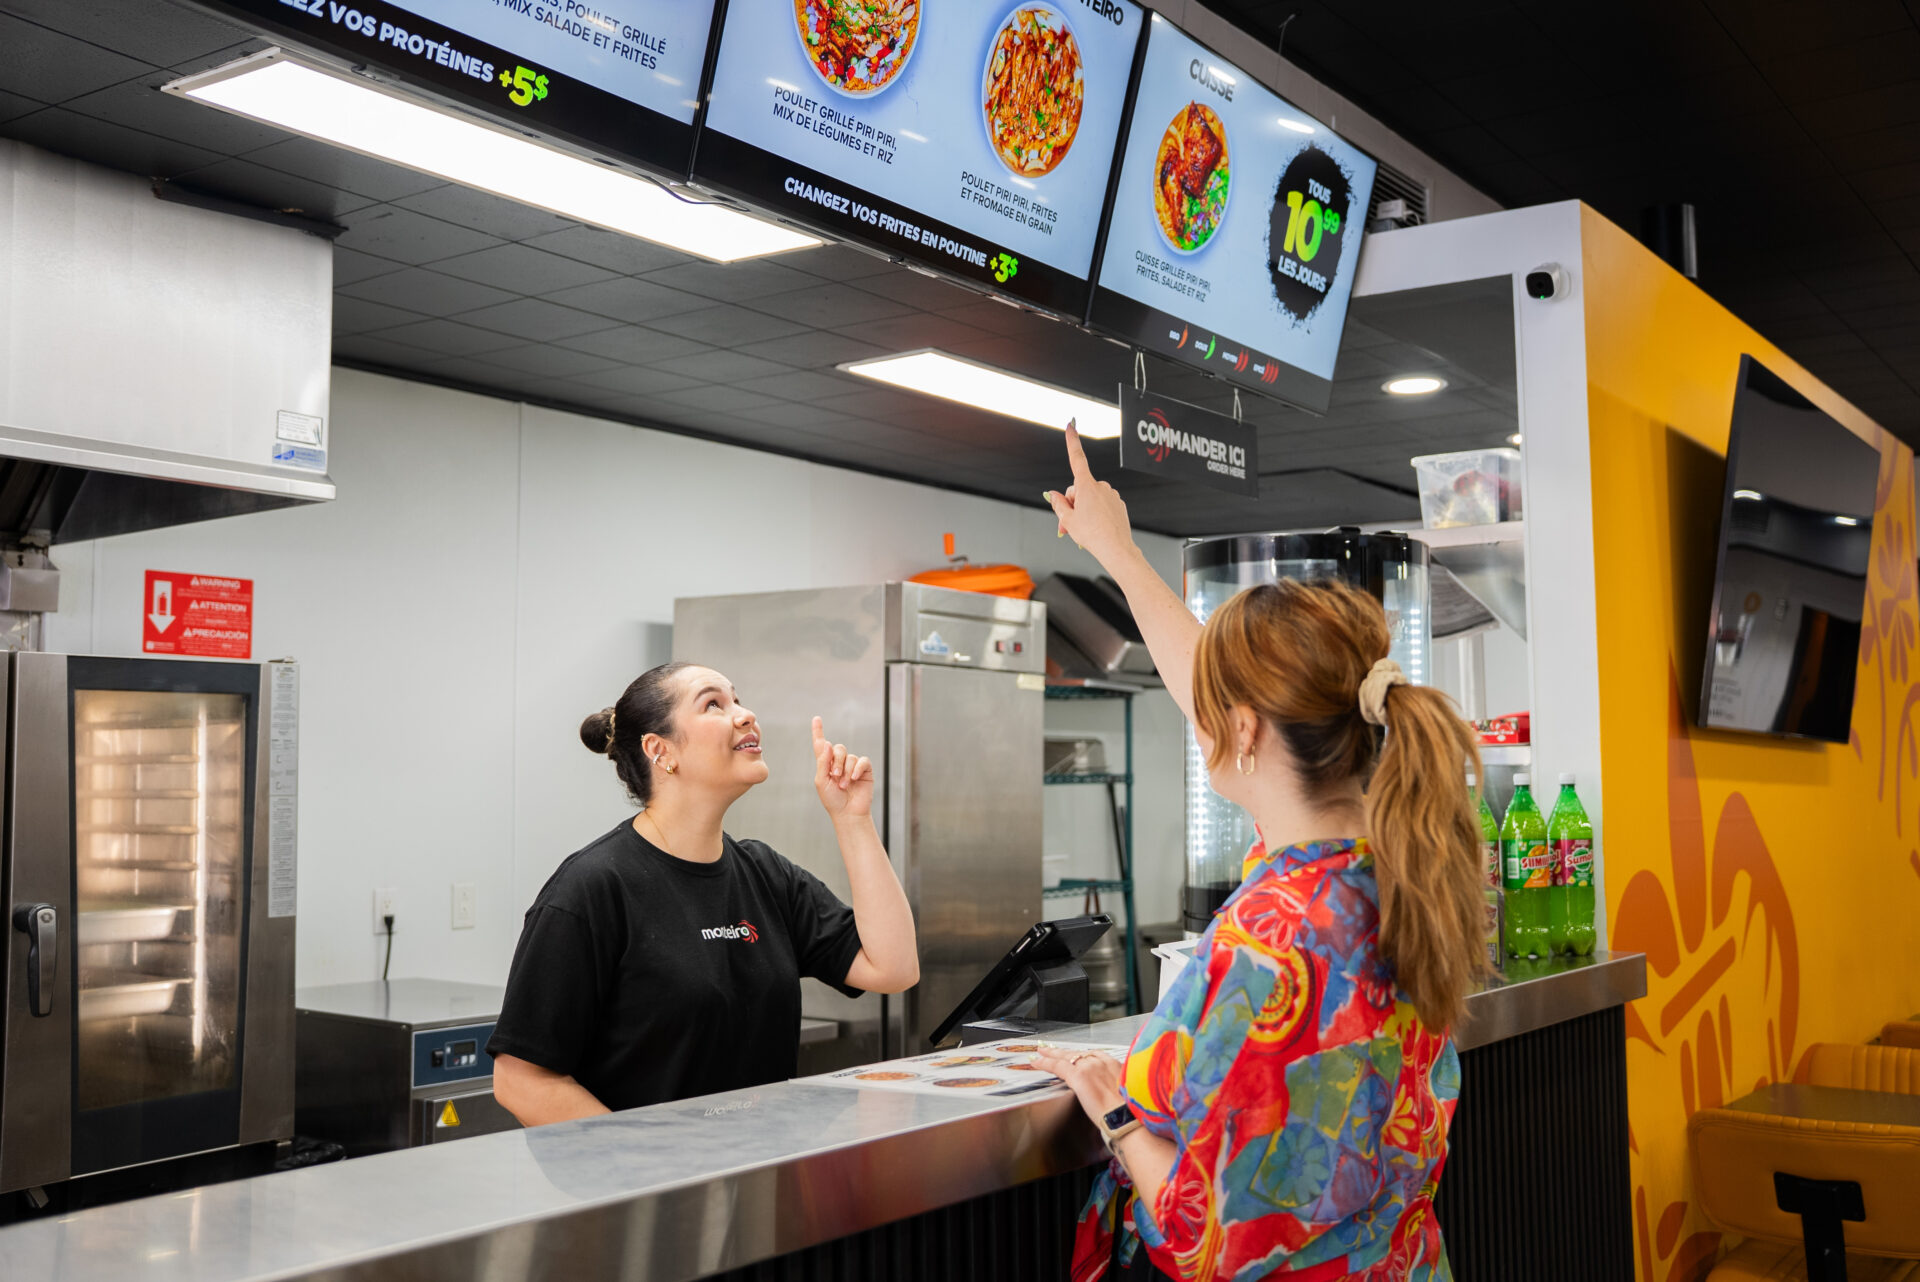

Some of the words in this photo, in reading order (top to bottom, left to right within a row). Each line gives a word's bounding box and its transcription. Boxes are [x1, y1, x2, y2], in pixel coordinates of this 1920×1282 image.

[504, 0, 531, 17] MIX
[535, 6, 591, 42] SALADE
[593, 32, 610, 50] ET
[613, 40, 657, 70] FRITES
[566, 0, 620, 33] POULET
[622, 25, 667, 55] GRILLÉ
[329, 1, 377, 37] VOS
[379, 22, 494, 82] PROTÉINES
[499, 65, 549, 106] +5$
[773, 103, 795, 123] MIX
[796, 113, 812, 130] DE
[813, 120, 861, 151] LÉGUMES
[863, 142, 876, 157] ET
[877, 148, 893, 165] RIZ
[774, 86, 818, 114] POULET
[819, 105, 855, 131] GRILLÉ
[856, 121, 875, 140] PIRI
[876, 131, 897, 151] PIRI,
[961, 171, 995, 194] POULET
[995, 186, 1012, 202] PIRI
[1012, 194, 1029, 212] PIRI,
[1031, 202, 1058, 222] FRITES
[961, 187, 972, 200] ET
[973, 192, 1015, 219] FROMAGE
[1015, 211, 1027, 225] EN
[1028, 216, 1053, 235] GRAIN
[1308, 178, 1331, 205] TOUS
[784, 177, 850, 215] CHANGEZ
[851, 202, 879, 225] VOS
[878, 214, 920, 242] FRITES
[920, 231, 940, 249] EN
[938, 238, 987, 267] POUTINE
[990, 252, 1018, 283] +3$
[1135, 250, 1160, 269] CUISSE
[1160, 261, 1186, 281] GRILLÉE
[1186, 273, 1198, 285] PIRI
[1136, 265, 1160, 284] FRITES,
[1161, 276, 1186, 294] SALADE
[1187, 287, 1195, 298] ET
[1195, 291, 1206, 302] RIZ
[1277, 255, 1297, 278] LES
[1295, 263, 1327, 293] JOURS
[1137, 420, 1227, 462] COMMANDER
[1228, 445, 1245, 467] ICI
[1207, 460, 1229, 475] ORDER
[1229, 466, 1246, 480] HERE
[200, 577, 240, 590] WARNING
[200, 601, 247, 613] ATTENTION
[192, 628, 249, 640] PRECAUCIÓN
[1565, 850, 1592, 868] Sumo
